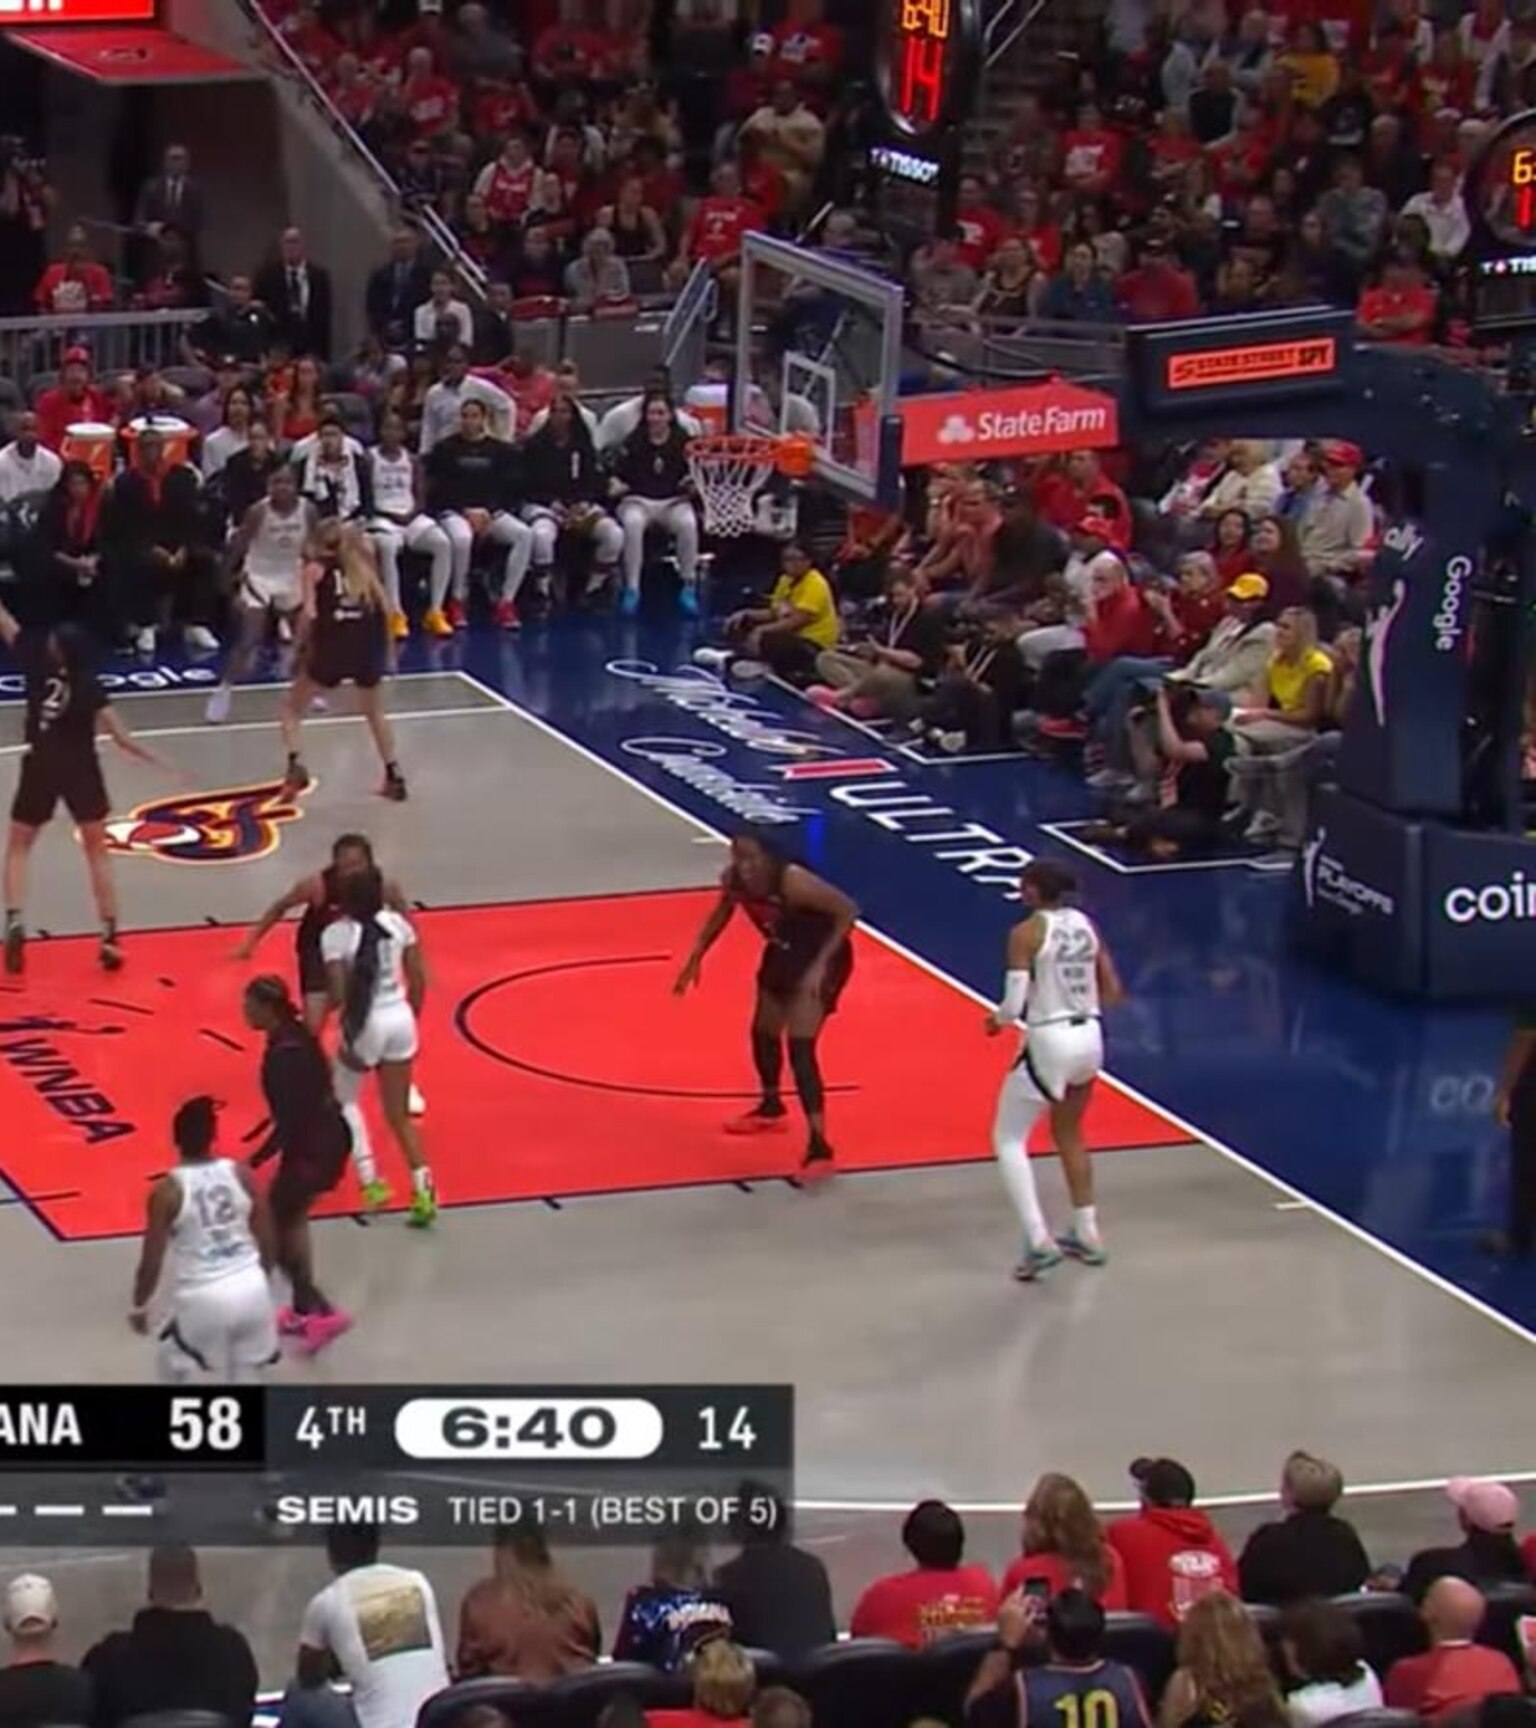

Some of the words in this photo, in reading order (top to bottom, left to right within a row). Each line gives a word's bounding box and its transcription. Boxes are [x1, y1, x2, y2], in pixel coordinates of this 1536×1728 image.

[1432, 555, 1473, 650] Google
[1051, 926, 1095, 963] 22
[196, 1184, 237, 1229] 12
[1054, 1687, 1120, 1728] 10
